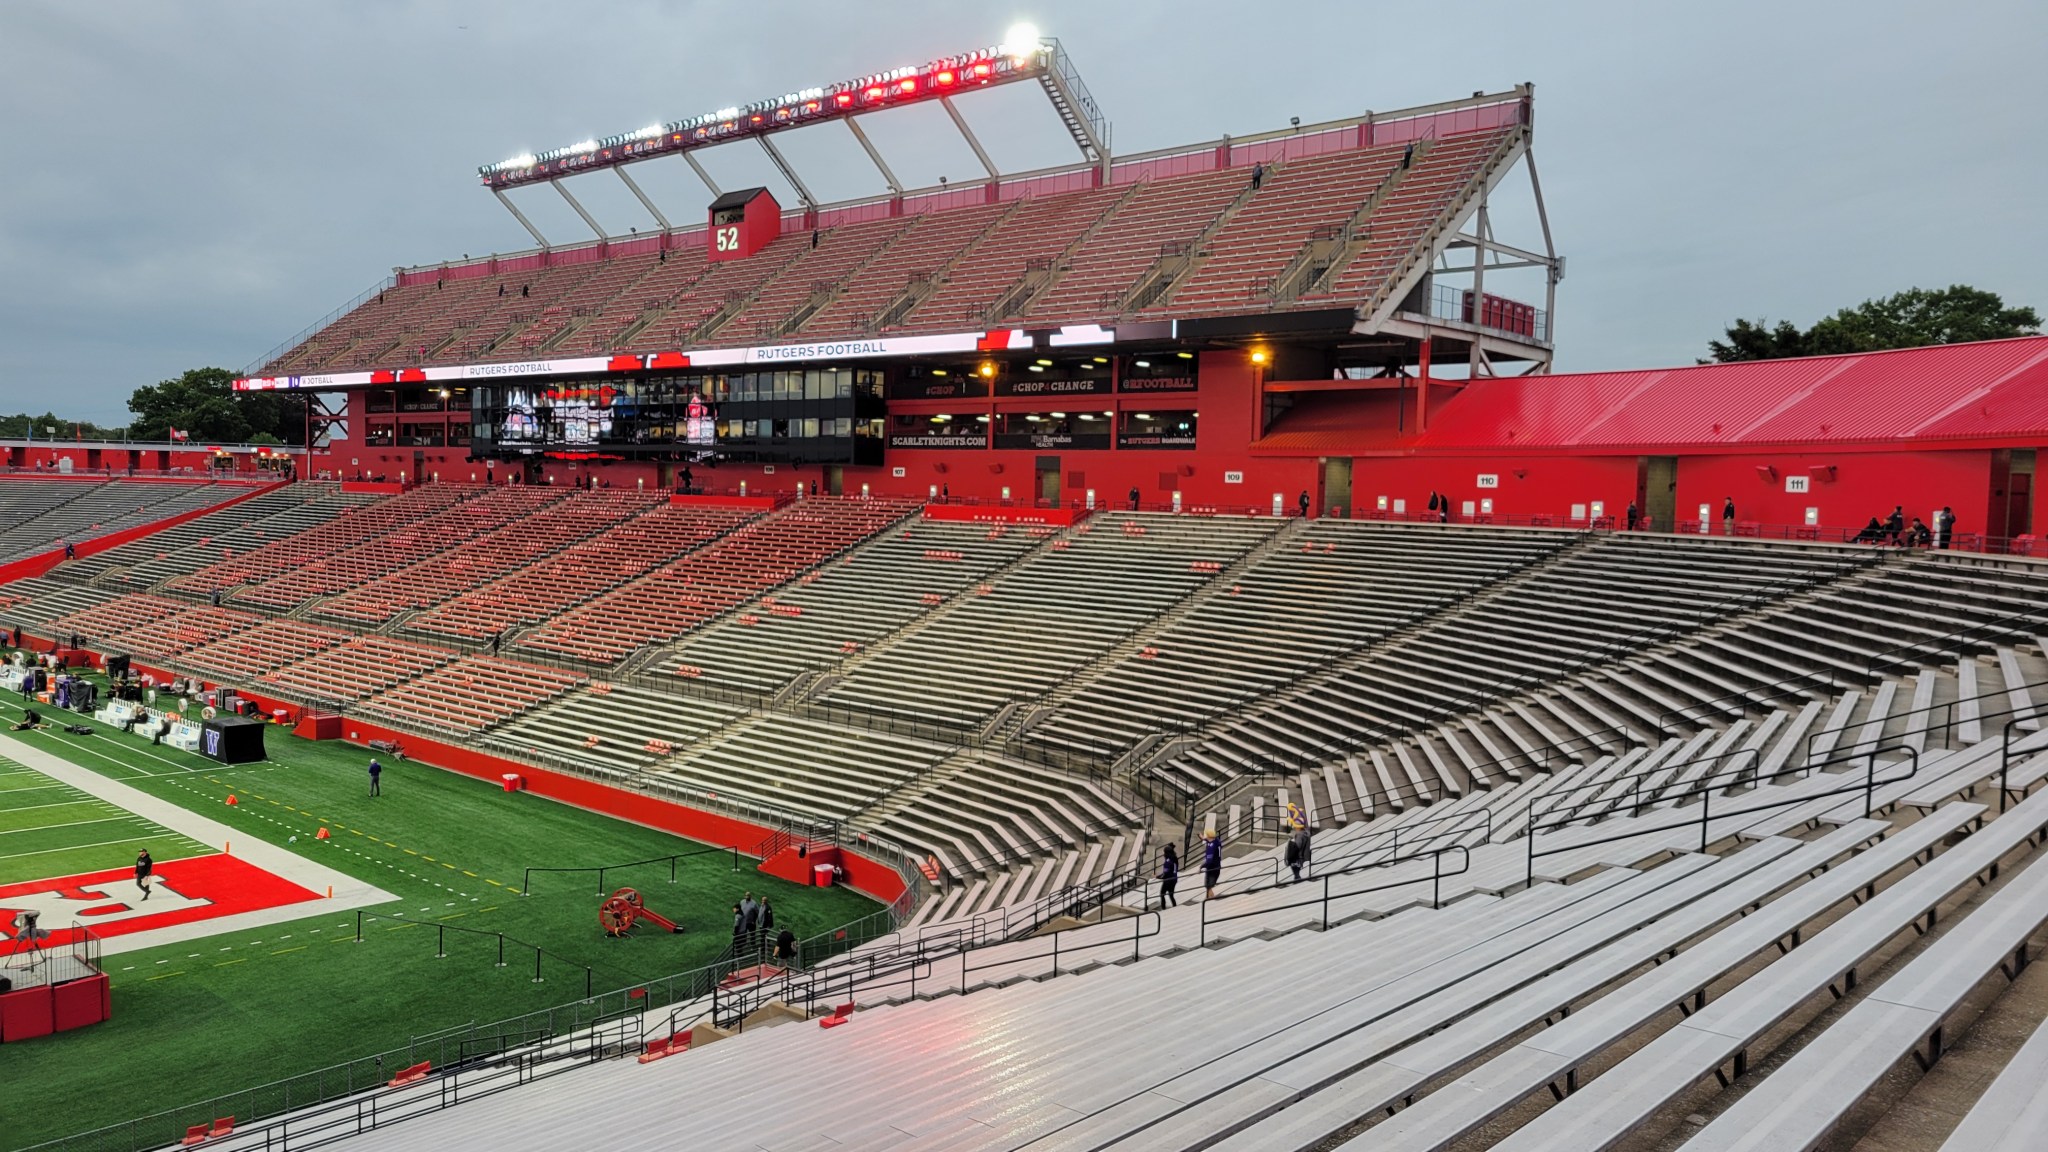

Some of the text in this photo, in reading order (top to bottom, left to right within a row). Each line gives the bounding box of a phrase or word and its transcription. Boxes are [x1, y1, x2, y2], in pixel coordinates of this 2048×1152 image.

[717, 227, 738, 251] 52
[757, 342, 887, 360] RUTGERS FOOTBALL
[469, 362, 553, 376] RUTGERS FOOTBALL
[926, 385, 955, 395] #CHOP
[1012, 380, 1094, 393] #CHOP4CHANGE
[892, 436, 986, 447] SCARLETKNIGHTS.COM
[1227, 473, 1240, 481] 109
[1480, 477, 1494, 485] 110
[1790, 479, 1804, 490] 111
[205, 728, 220, 756] W
